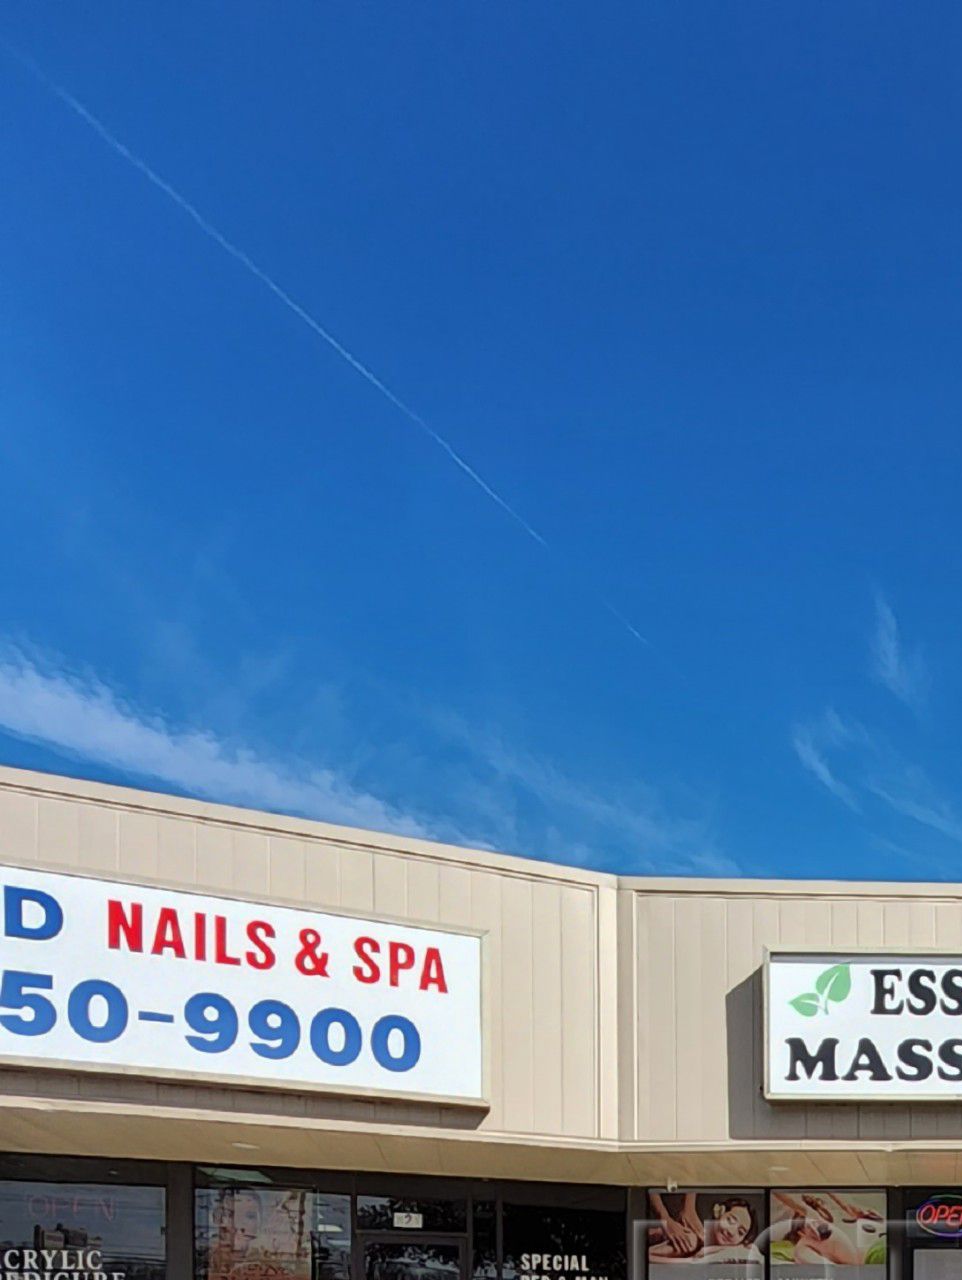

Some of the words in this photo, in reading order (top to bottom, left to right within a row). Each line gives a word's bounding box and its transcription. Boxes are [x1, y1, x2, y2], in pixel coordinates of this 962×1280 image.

[3, 885, 63, 940] D
[108, 899, 276, 970] NAILS
[295, 928, 330, 978] &
[353, 937, 449, 994] SPA
[0, 969, 422, 1073] 50-9900
[0, 1249, 102, 1270] CRYLIC
[521, 1253, 589, 1271] SPECIAL
